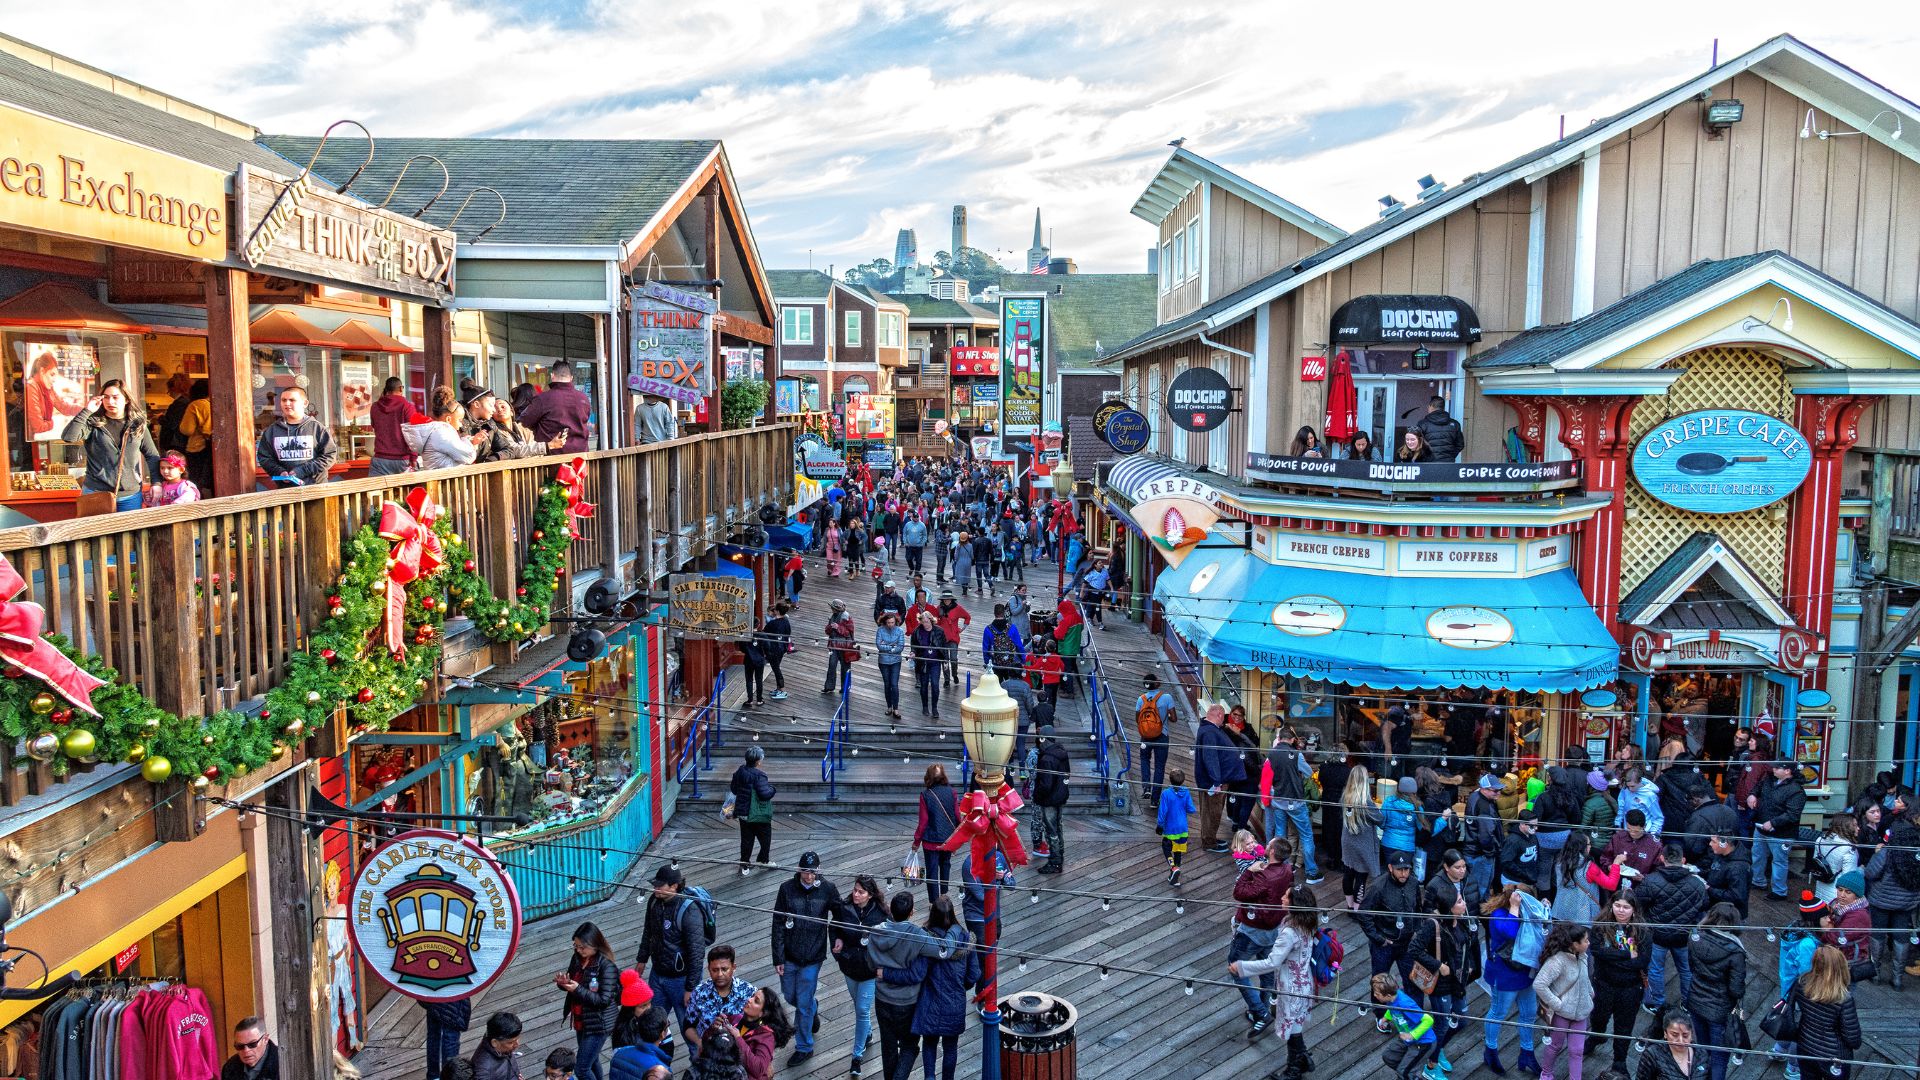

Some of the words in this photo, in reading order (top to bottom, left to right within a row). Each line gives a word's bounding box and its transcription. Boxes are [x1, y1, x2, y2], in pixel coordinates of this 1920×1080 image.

[0, 157, 48, 198] ea
[60, 155, 221, 247] Exchange
[294, 207, 371, 267] THINK
[374, 218, 399, 242] OUT
[379, 239, 399, 261] OF
[400, 236, 455, 284] BOX
[374, 260, 400, 282] THE
[639, 311, 703, 328] THINK
[1382, 309, 1459, 329] DOUGHP
[1382, 329, 1405, 338] LEGIT
[1405, 329, 1430, 338] COOKIE
[965, 351, 980, 360] NFL
[981, 351, 999, 361] Shop
[642, 356, 703, 388] BOX
[630, 375, 696, 403] PUZZLES
[1174, 390, 1227, 404] DOUGHP
[1111, 420, 1145, 435] Crystal
[1115, 433, 1140, 450] Shop
[1737, 416, 1804, 461] CAFE
[1300, 461, 1336, 473] DOUGH
[1370, 464, 1421, 480] DOUGHP
[1459, 466, 1502, 478] EDIBLE
[1137, 479, 1218, 502] CREPES
[1663, 483, 1719, 495] FRENCH
[1291, 541, 1329, 556] FRENCH
[1332, 545, 1370, 559] CREPES
[1416, 550, 1445, 562] FINE
[1449, 550, 1498, 563] COFFEES
[674, 583, 690, 595] SAN
[695, 581, 748, 599] FRANCISCO'S
[673, 599, 749, 614] WILDER
[684, 610, 737, 624] WEST
[1251, 649, 1335, 674] BREAKFAST
[1585, 661, 1614, 681] DINNER
[1450, 669, 1511, 683] LUNCH
[365, 841, 431, 886] CABLE
[438, 843, 483, 878] CAR
[358, 889, 374, 925] THE
[479, 876, 507, 930] STORE
[411, 944, 423, 952] SAN
[423, 943, 453, 954] FRANCISCO
